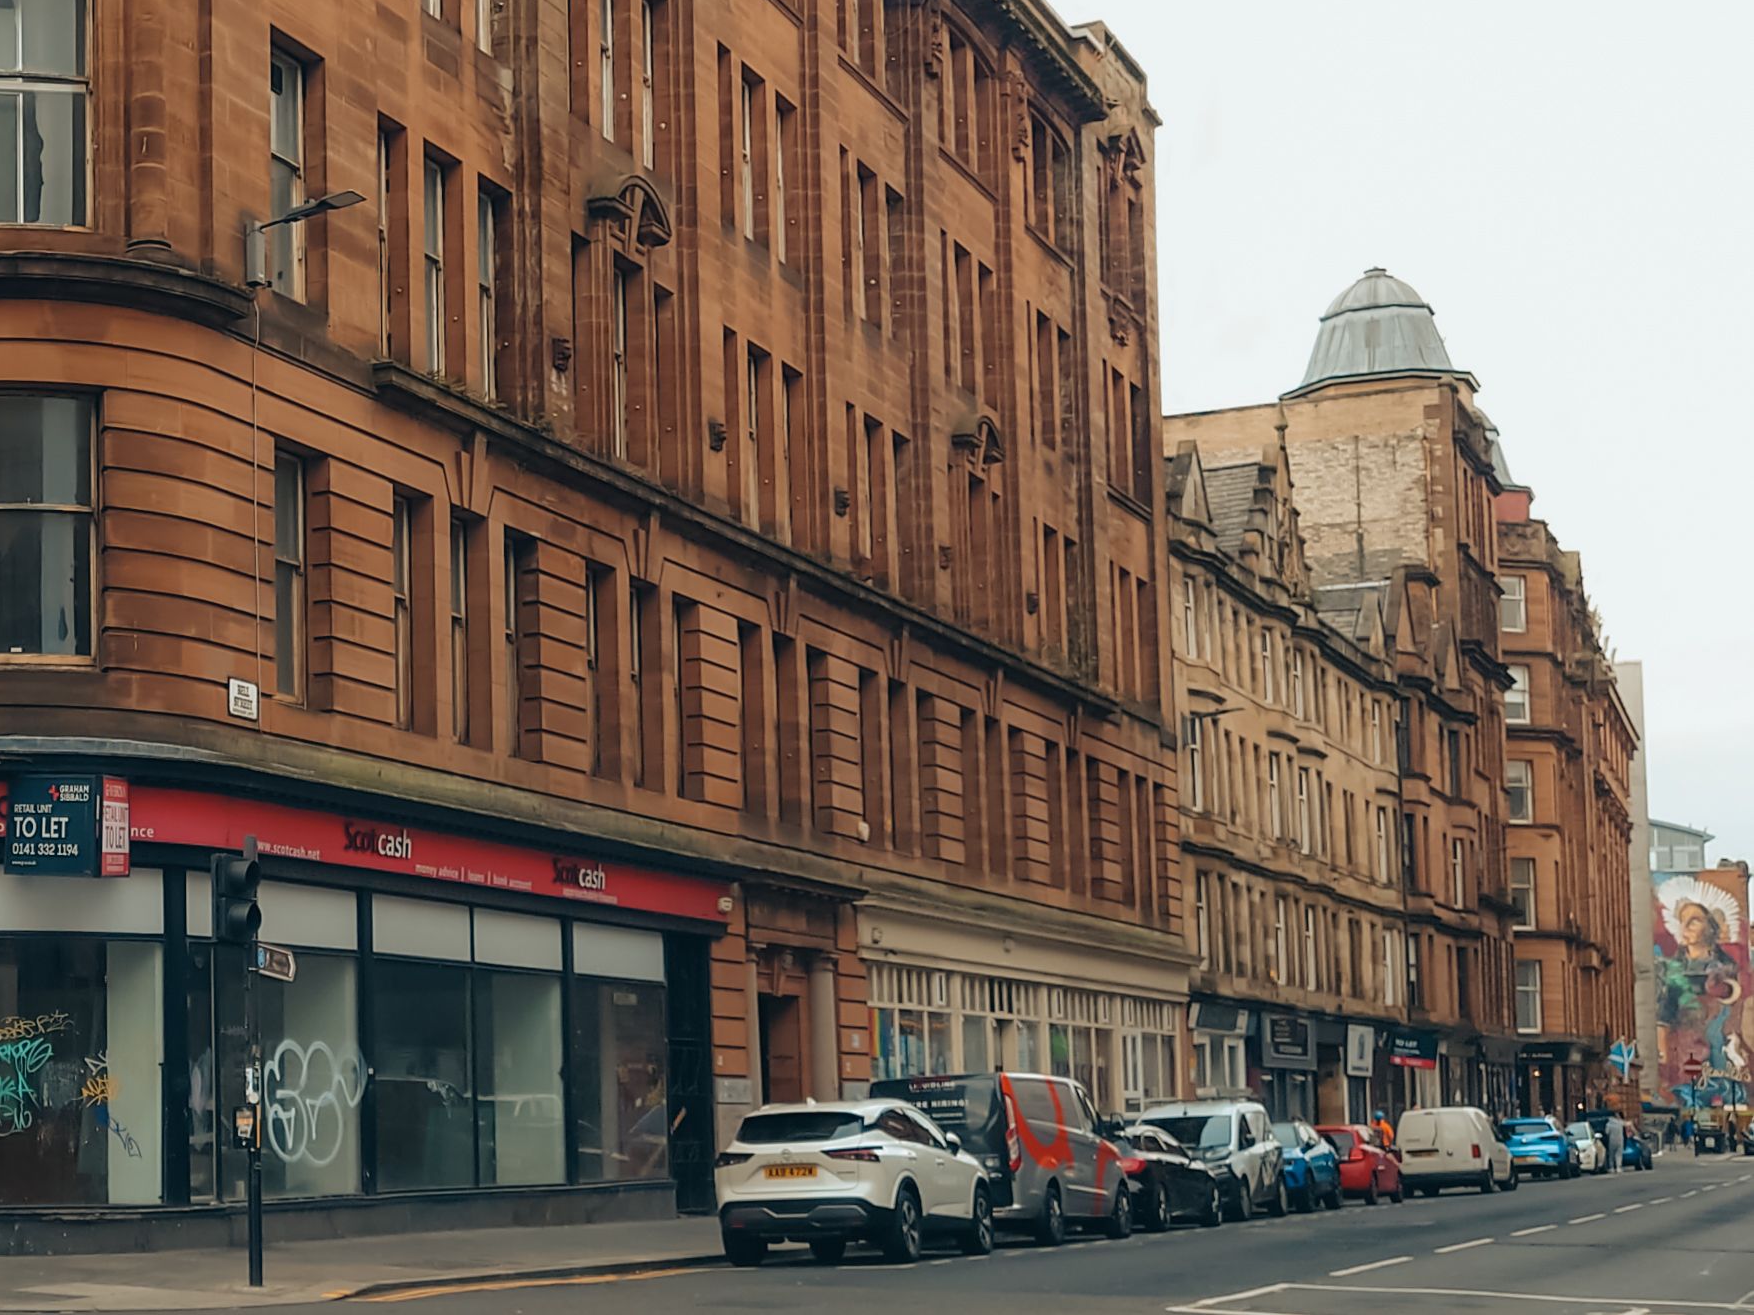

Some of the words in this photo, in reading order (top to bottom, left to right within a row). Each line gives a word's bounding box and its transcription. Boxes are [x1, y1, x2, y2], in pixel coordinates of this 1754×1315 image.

[59, 785, 89, 793] GRAHAM
[59, 793, 89, 802] SIBBALD
[14, 804, 36, 814] RETAIL
[37, 804, 52, 814] UNIT
[13, 816, 37, 838] TO
[42, 816, 69, 838] LET
[12, 843, 36, 855] 0141
[37, 843, 55, 856] 332
[57, 844, 78, 856] 1194
